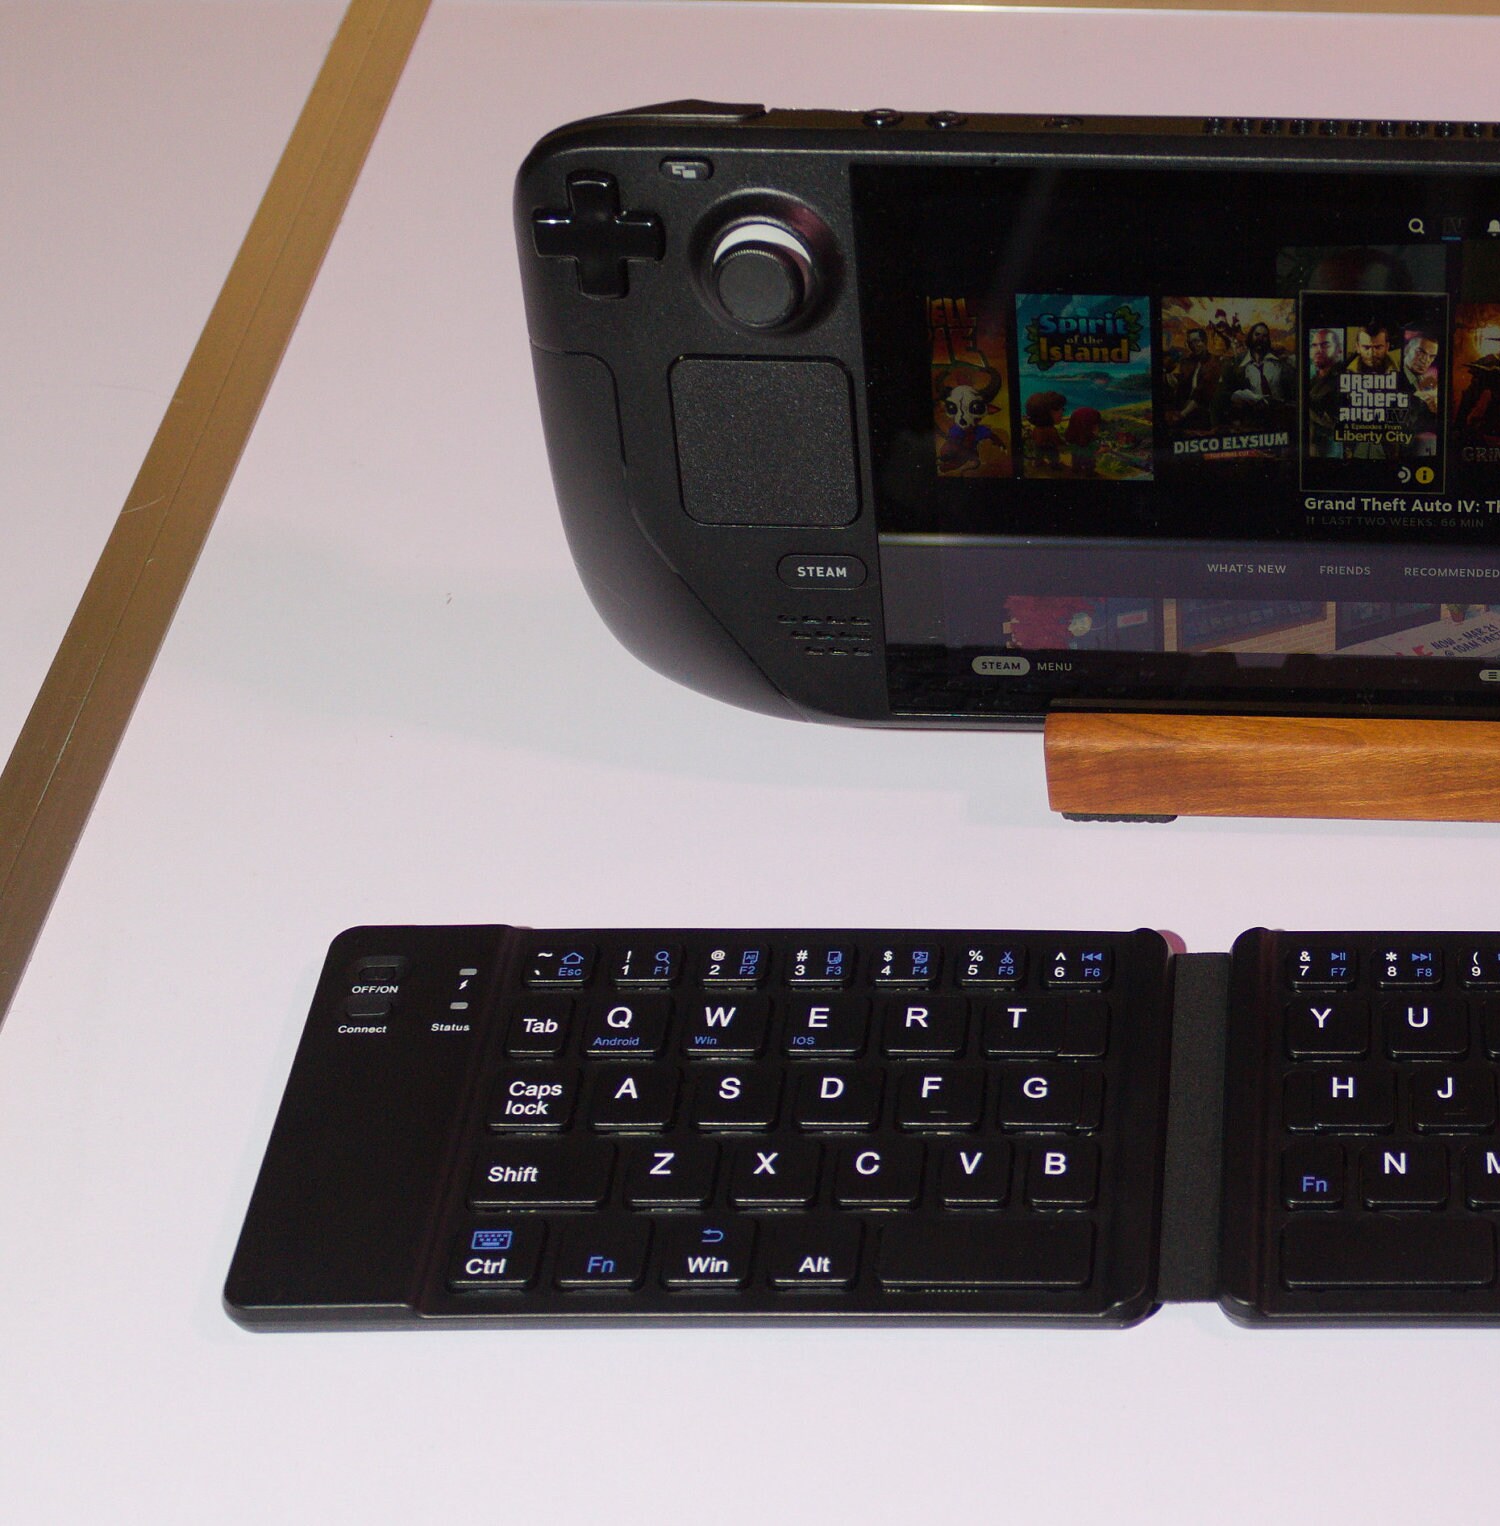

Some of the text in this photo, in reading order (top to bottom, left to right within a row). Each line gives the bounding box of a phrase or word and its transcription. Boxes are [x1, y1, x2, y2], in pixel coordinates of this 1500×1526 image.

[1039, 312, 1128, 336] Spirit
[1066, 335, 1104, 345] of the
[1039, 336, 1129, 363] Island
[1350, 389, 1408, 407] theft
[1340, 407, 1385, 421] auto
[1173, 432, 1288, 454] DISCO ELYSIUM
[1335, 430, 1413, 444] Liberty City
[1304, 497, 1356, 511] Grand
[1360, 498, 1407, 511] Theft
[1411, 500, 1452, 512] Auto
[1457, 500, 1480, 513] IV:
[1321, 516, 1351, 526] LAST
[1357, 516, 1386, 526] TWO
[1460, 519, 1485, 529] MIN
[797, 566, 847, 577] STEAM
[1207, 563, 1287, 574] WHAT'S NEW
[1319, 566, 1371, 576] FRIENDS
[1404, 567, 1500, 579] RECOMMENDED
[981, 660, 1072, 672] STEAM MENU
[626, 951, 631, 962] !
[711, 950, 725, 961] @
[797, 950, 808, 961] #
[884, 951, 892, 962] $
[969, 950, 983, 961] %
[1300, 951, 1310, 961] &
[558, 967, 581, 976] Esc
[622, 965, 629, 975] 1
[654, 966, 669, 974] F1
[709, 965, 720, 975] 2
[740, 963, 755, 974] F2
[795, 965, 805, 975] 3
[826, 963, 841, 975] F3
[881, 965, 891, 975] 4
[912, 963, 928, 974] F4
[968, 965, 978, 975] 5
[999, 963, 1014, 975] F5
[1055, 967, 1064, 977] 6
[1085, 968, 1100, 977] F6
[1300, 966, 1309, 976] 7
[1331, 968, 1346, 976] F7
[1388, 966, 1396, 976] 8
[1417, 968, 1432, 976] F8
[1472, 967, 1480, 976] 9
[607, 1007, 632, 1028] Q
[706, 1007, 736, 1027] W
[809, 1008, 829, 1027] E
[906, 1008, 928, 1027] R
[1008, 1008, 1027, 1028] T
[1310, 1008, 1331, 1028] Y
[1408, 1008, 1428, 1027] U
[431, 1023, 469, 1031] Status
[524, 1019, 558, 1033] Tab
[593, 1037, 639, 1046] Android
[695, 1036, 717, 1044] Win
[509, 1081, 562, 1099] Caps
[615, 1078, 637, 1098] A
[719, 1078, 740, 1099] S
[821, 1078, 843, 1098] D
[922, 1077, 942, 1097] F
[1023, 1077, 1047, 1098] G
[1333, 1077, 1353, 1097] H
[1437, 1077, 1452, 1098] J
[505, 1101, 548, 1114] lock
[650, 1153, 674, 1174] Z
[754, 1153, 778, 1174] X
[856, 1152, 880, 1174] C
[960, 1152, 982, 1174] V
[1045, 1153, 1066, 1174] B
[1384, 1152, 1406, 1174] N
[488, 1167, 538, 1182] Shift
[1303, 1176, 1327, 1192] Fn
[466, 1259, 506, 1274] Ctrl
[587, 1256, 614, 1272] Fn
[688, 1257, 728, 1272] Win
[799, 1257, 830, 1272] Alt
